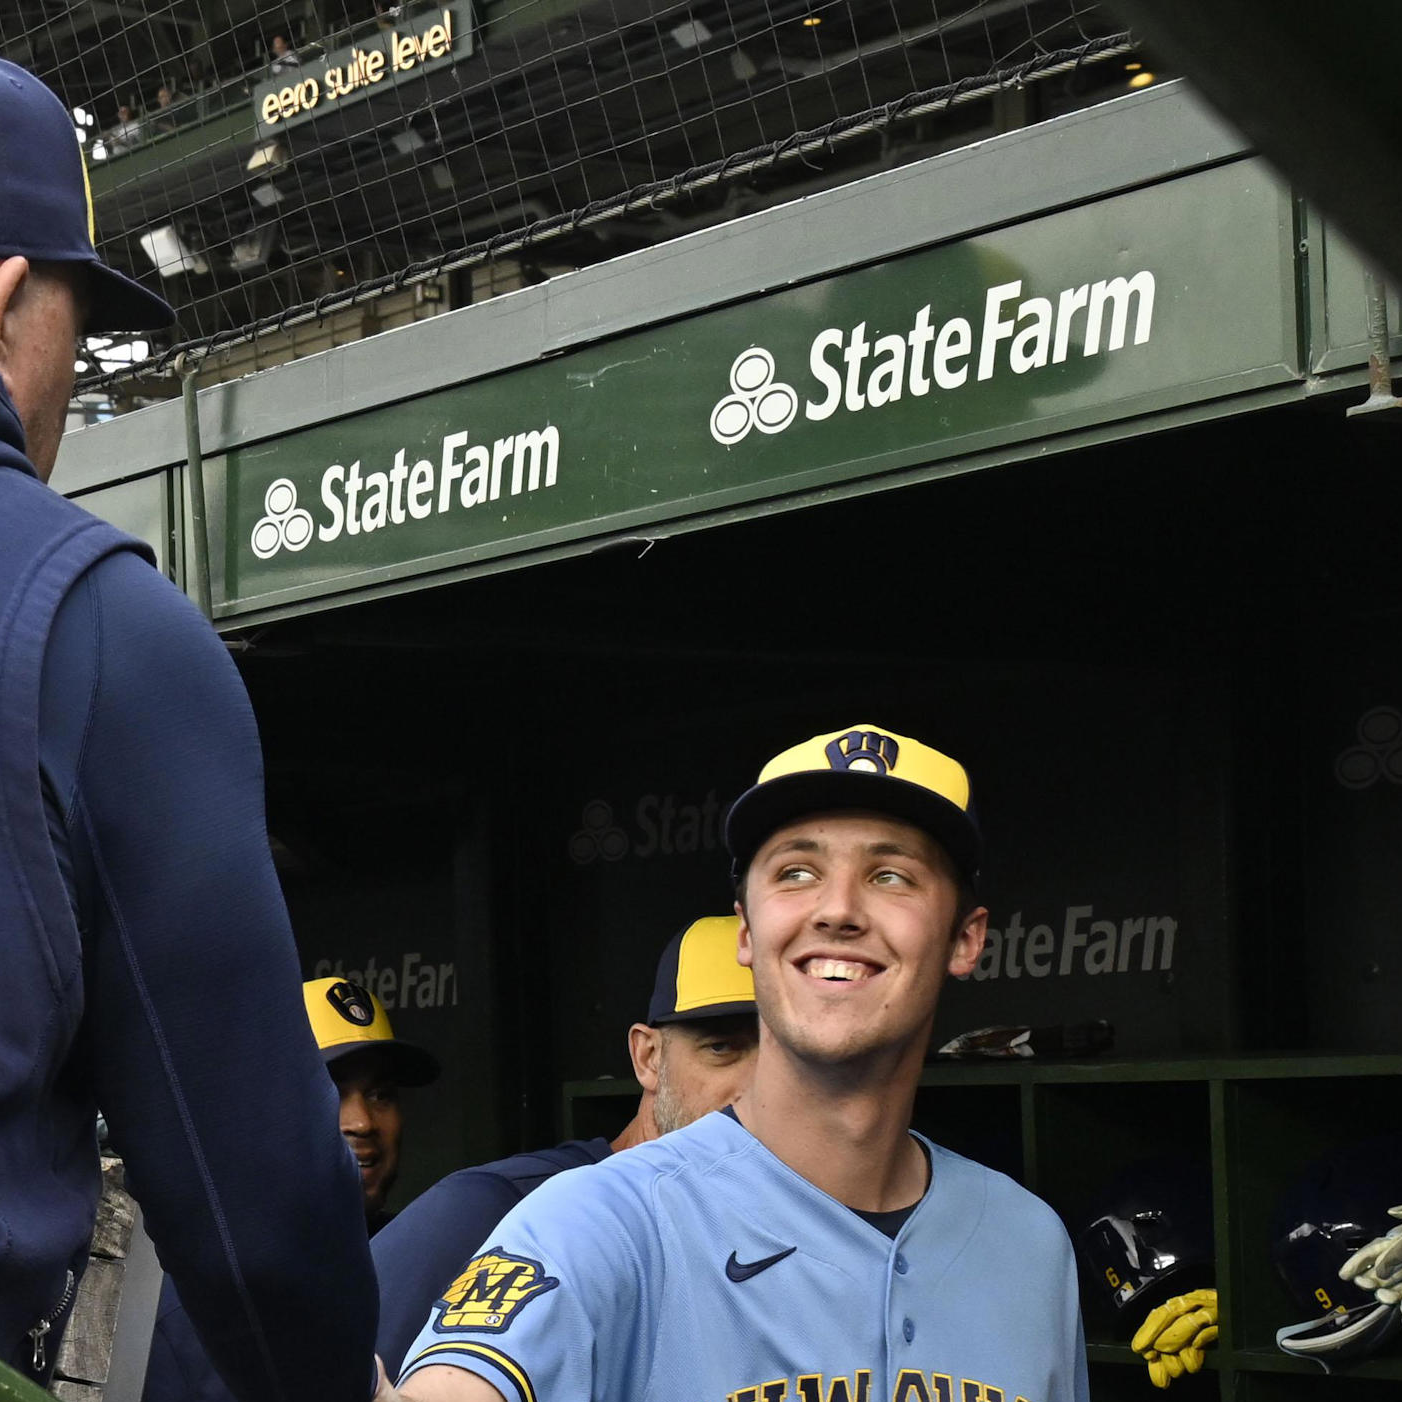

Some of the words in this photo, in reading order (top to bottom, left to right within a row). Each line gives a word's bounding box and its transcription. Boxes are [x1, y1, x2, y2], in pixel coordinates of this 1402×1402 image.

[262, 78, 320, 125] eero
[324, 48, 385, 100] suite
[392, 9, 452, 72] level
[1105, 1267, 1120, 1289] 6
[1314, 1288, 1333, 1310] 9
